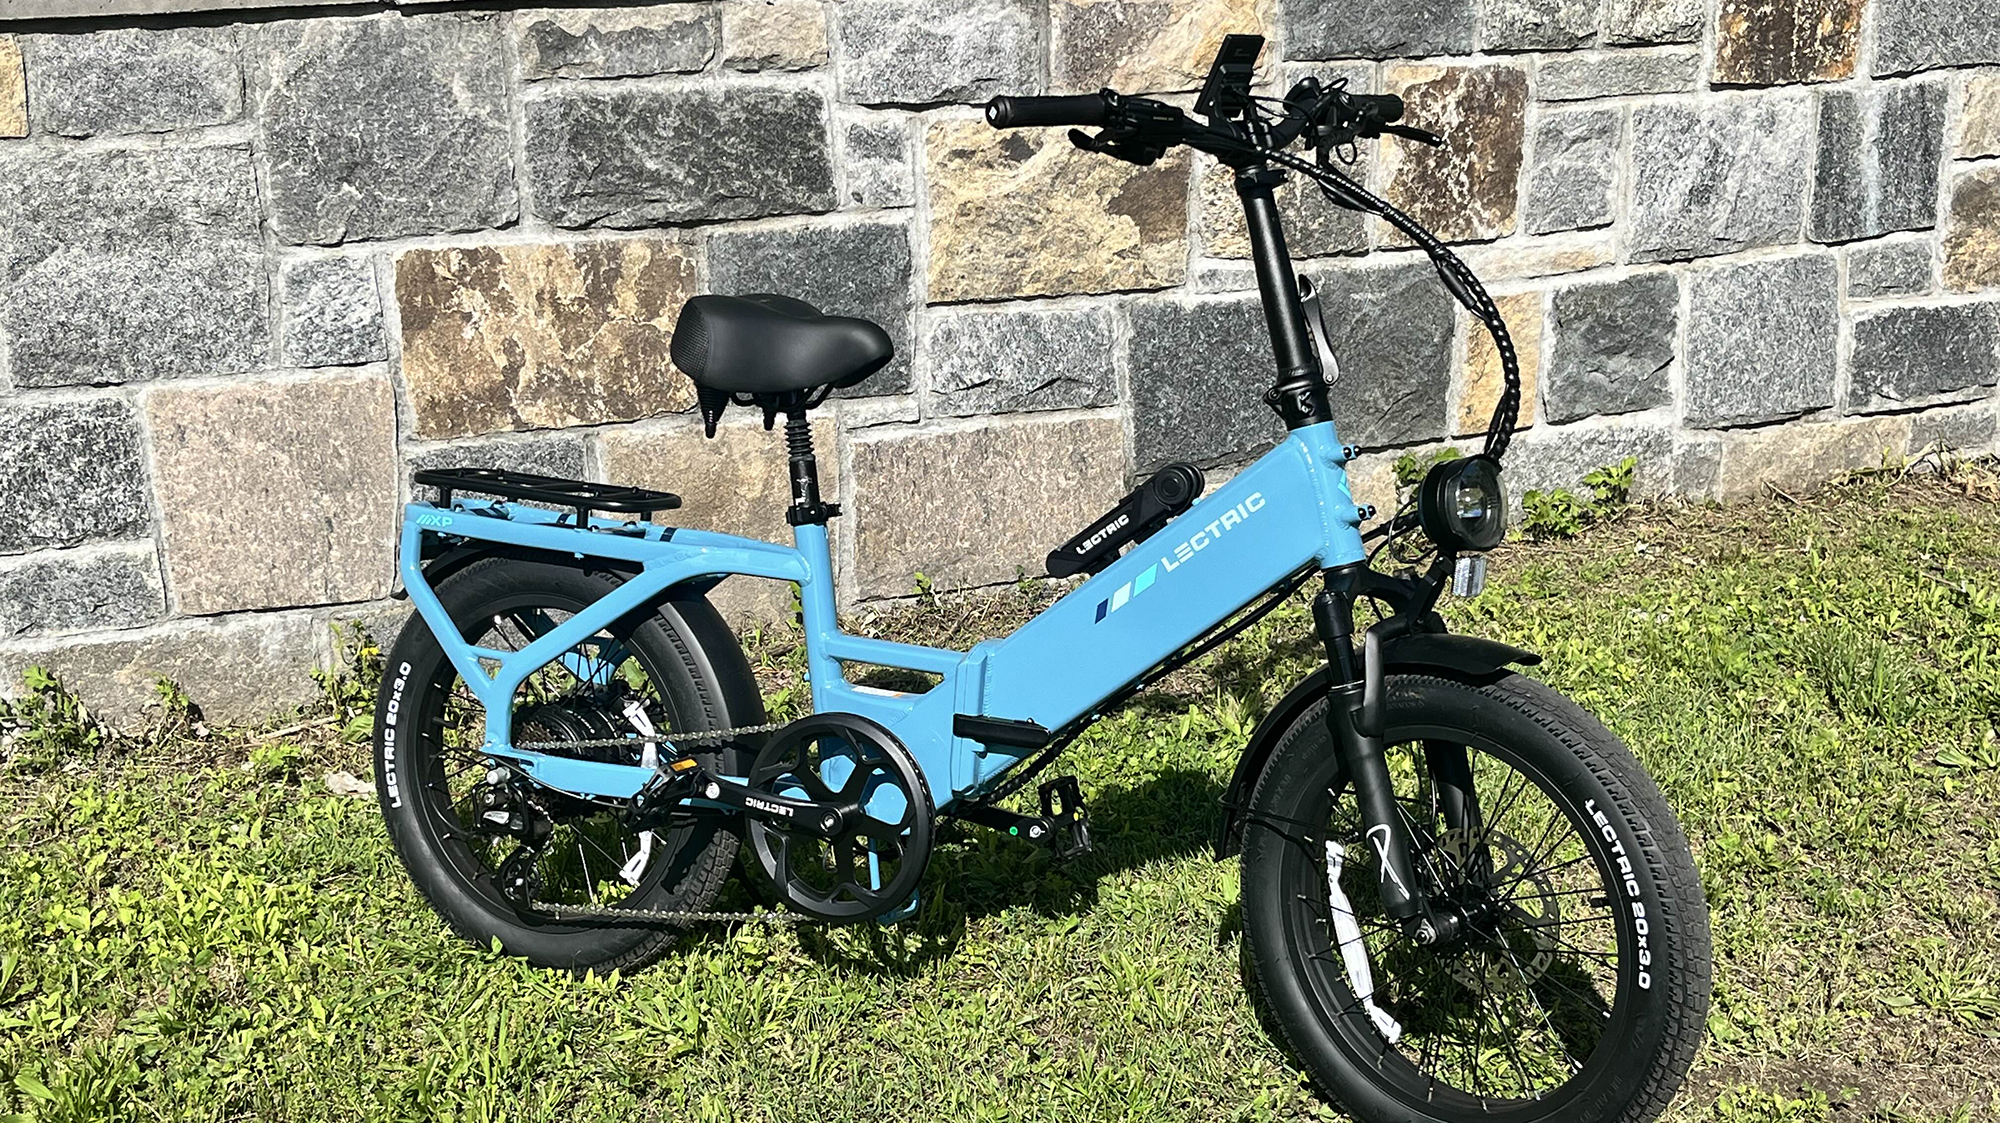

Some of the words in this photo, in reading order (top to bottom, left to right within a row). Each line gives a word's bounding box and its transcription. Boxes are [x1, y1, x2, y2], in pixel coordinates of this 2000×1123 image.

[1075, 514, 1130, 555] LECTRIC
[1160, 491, 1266, 573] LECTRIC
[386, 661, 412, 726] 20x3.0
[384, 727, 403, 809] LECTRIC
[745, 796, 794, 817] LECTRIC
[1584, 798, 1641, 898] LECTRIC
[1631, 901, 1651, 990] 20x3.0
